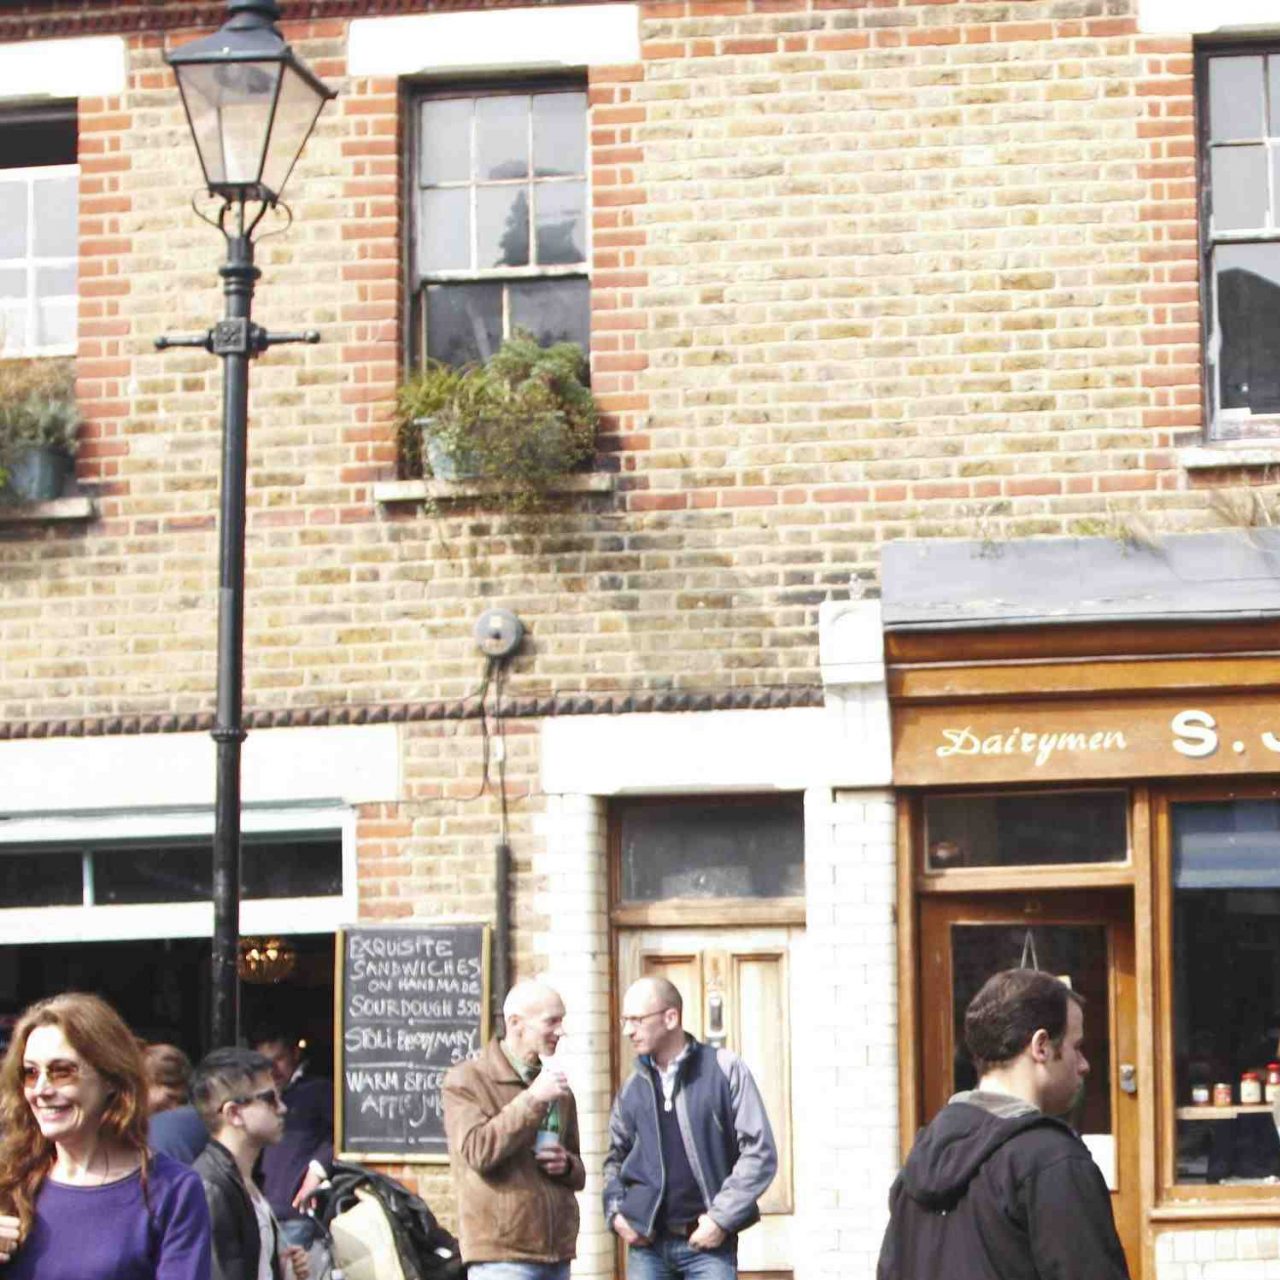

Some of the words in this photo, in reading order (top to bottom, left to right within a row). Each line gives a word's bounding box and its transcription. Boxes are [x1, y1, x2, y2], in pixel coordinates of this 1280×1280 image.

[936, 726, 1128, 767] Dairymen
[350, 958, 480, 980] SANDWICHES
[367, 980, 393, 993] ON
[349, 994, 453, 1018] SOURDOUGH
[345, 1070, 399, 1092] WARM
